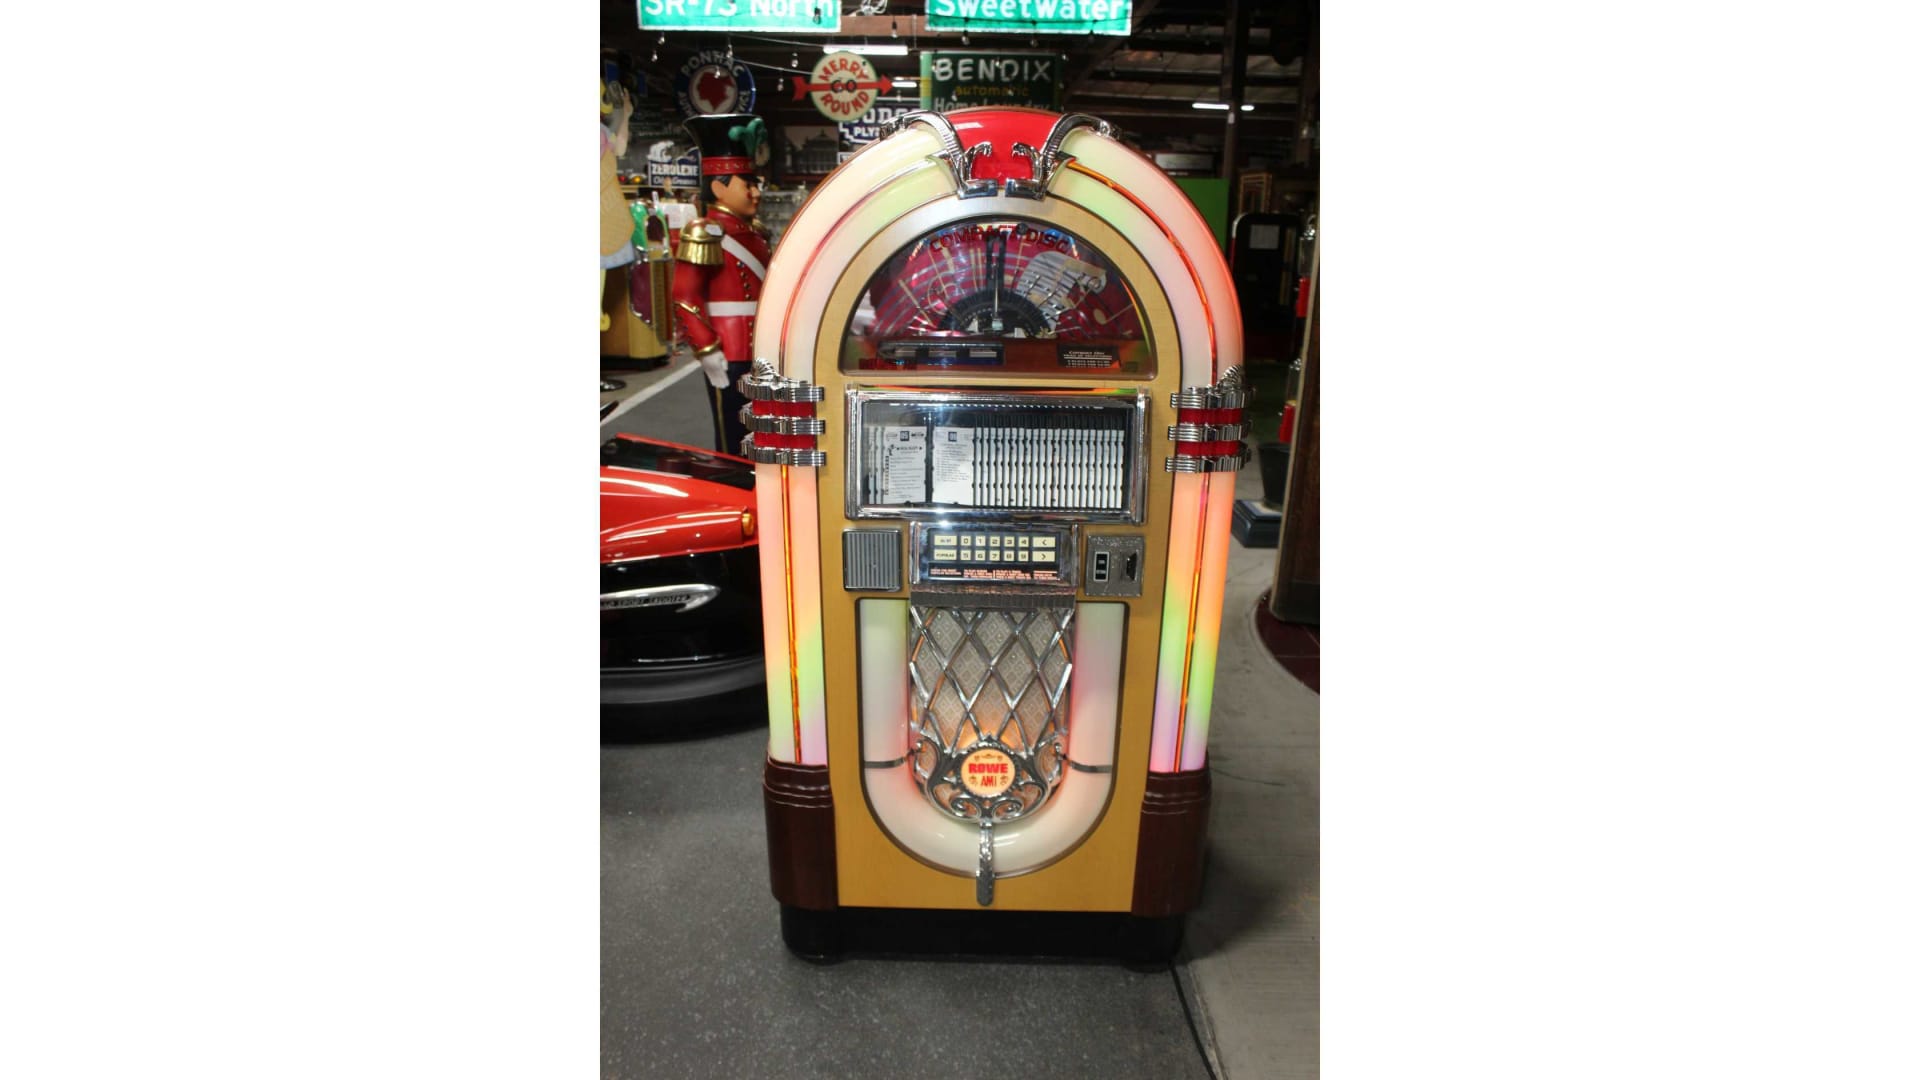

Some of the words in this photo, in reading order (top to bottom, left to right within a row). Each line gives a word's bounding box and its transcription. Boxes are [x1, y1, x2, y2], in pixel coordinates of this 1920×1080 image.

[750, 0, 835, 17] North
[935, 0, 1124, 19] Sweetwater
[680, 49, 745, 78] PONTIAC
[818, 57, 869, 81] MERRY
[933, 57, 1052, 82] BENDIX
[831, 79, 857, 93] GO
[955, 85, 1030, 97] automatic
[821, 91, 870, 116] ROUND
[929, 223, 1018, 253] COMPACT
[1025, 227, 1070, 255] DISC
[968, 762, 1009, 774] ROWE
[980, 775, 998, 788] AMI
